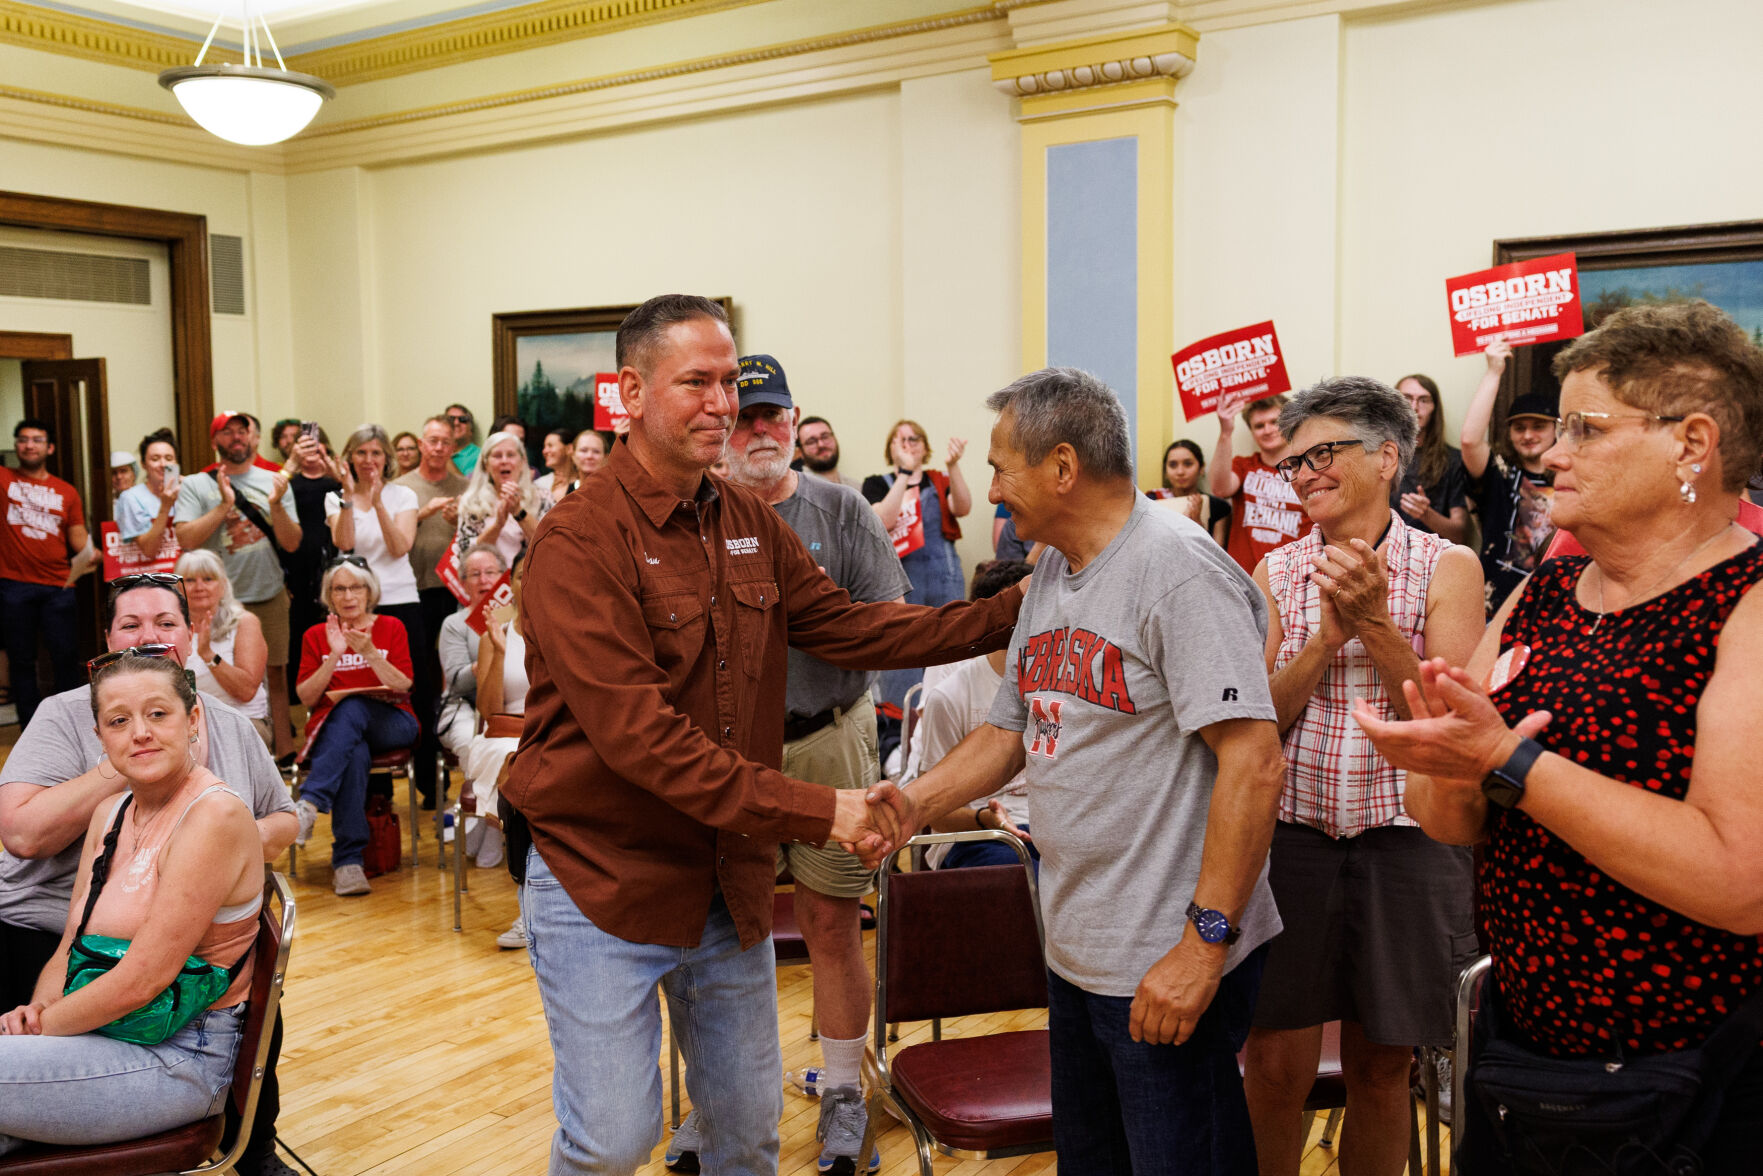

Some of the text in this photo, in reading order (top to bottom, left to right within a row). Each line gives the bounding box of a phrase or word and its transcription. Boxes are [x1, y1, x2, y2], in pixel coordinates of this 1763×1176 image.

[1451, 268, 1572, 312] OSBORN
[1471, 304, 1559, 332] FOR SENATE
[1176, 333, 1275, 383] OSBORN
[1195, 379, 1220, 397] FOR
[1220, 366, 1267, 388] SENATE
[1028, 697, 1067, 759] N
